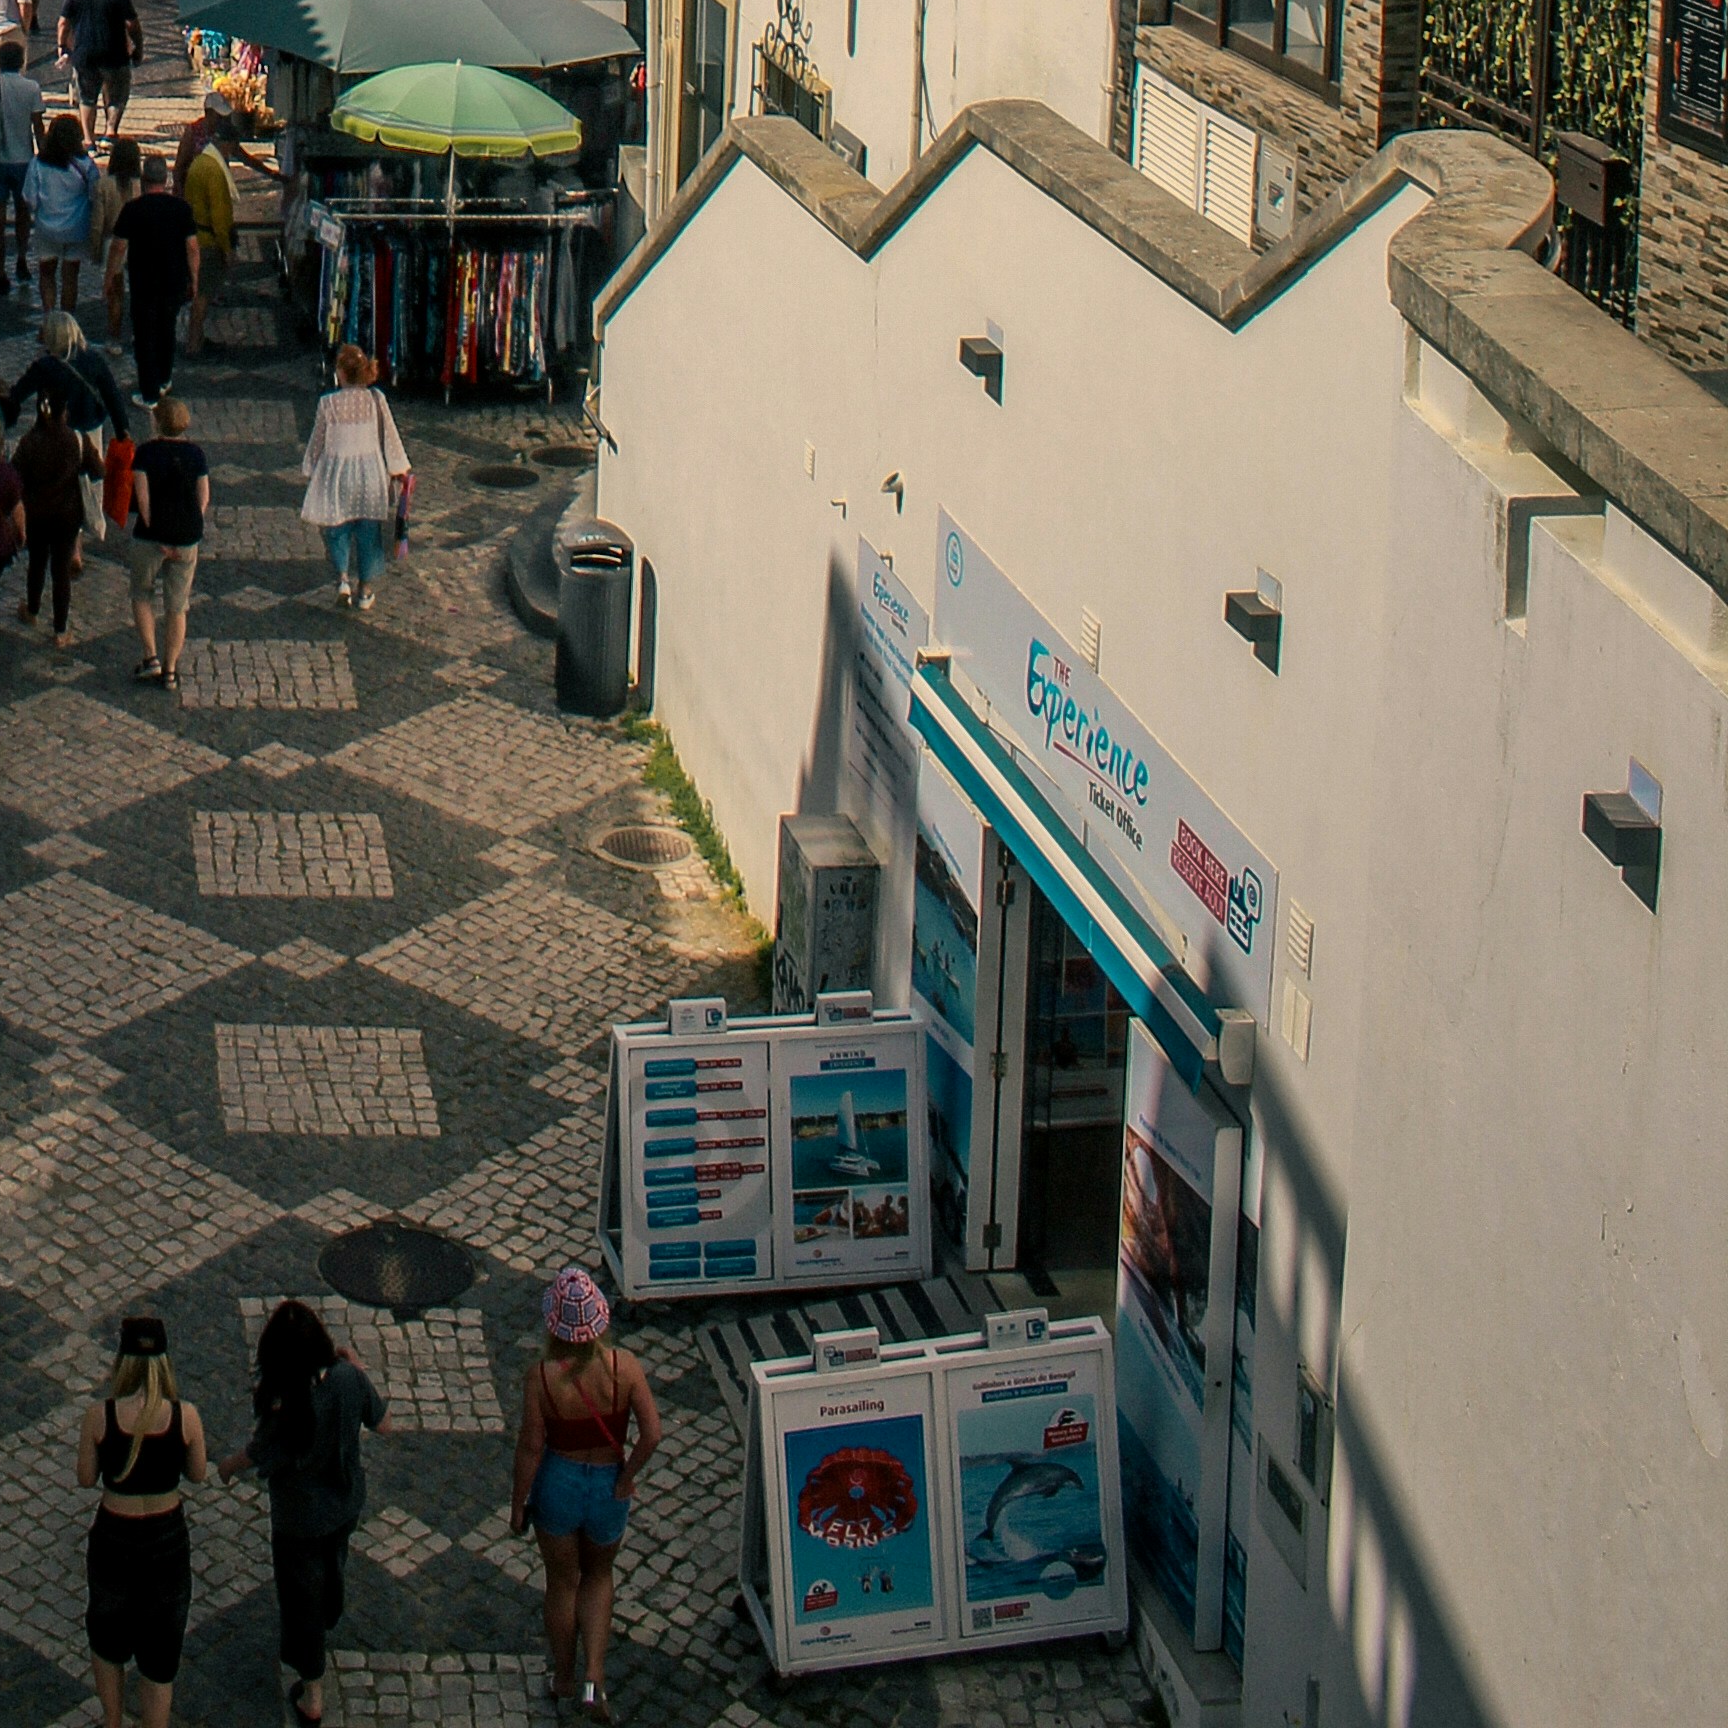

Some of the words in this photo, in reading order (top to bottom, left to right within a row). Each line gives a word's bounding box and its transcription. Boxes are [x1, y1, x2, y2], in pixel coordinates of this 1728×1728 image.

[1053, 655, 1071, 687] THE
[1027, 636, 1150, 807] Experience
[1088, 780, 1115, 823] Ticket
[1115, 805, 1143, 852] Office
[1173, 846, 1203, 897] RESERVE
[1180, 825, 1203, 867] BOOK
[1203, 851, 1226, 892] HERE
[820, 1400, 885, 1418] Parasailing
[829, 1519, 871, 1539] FLY
